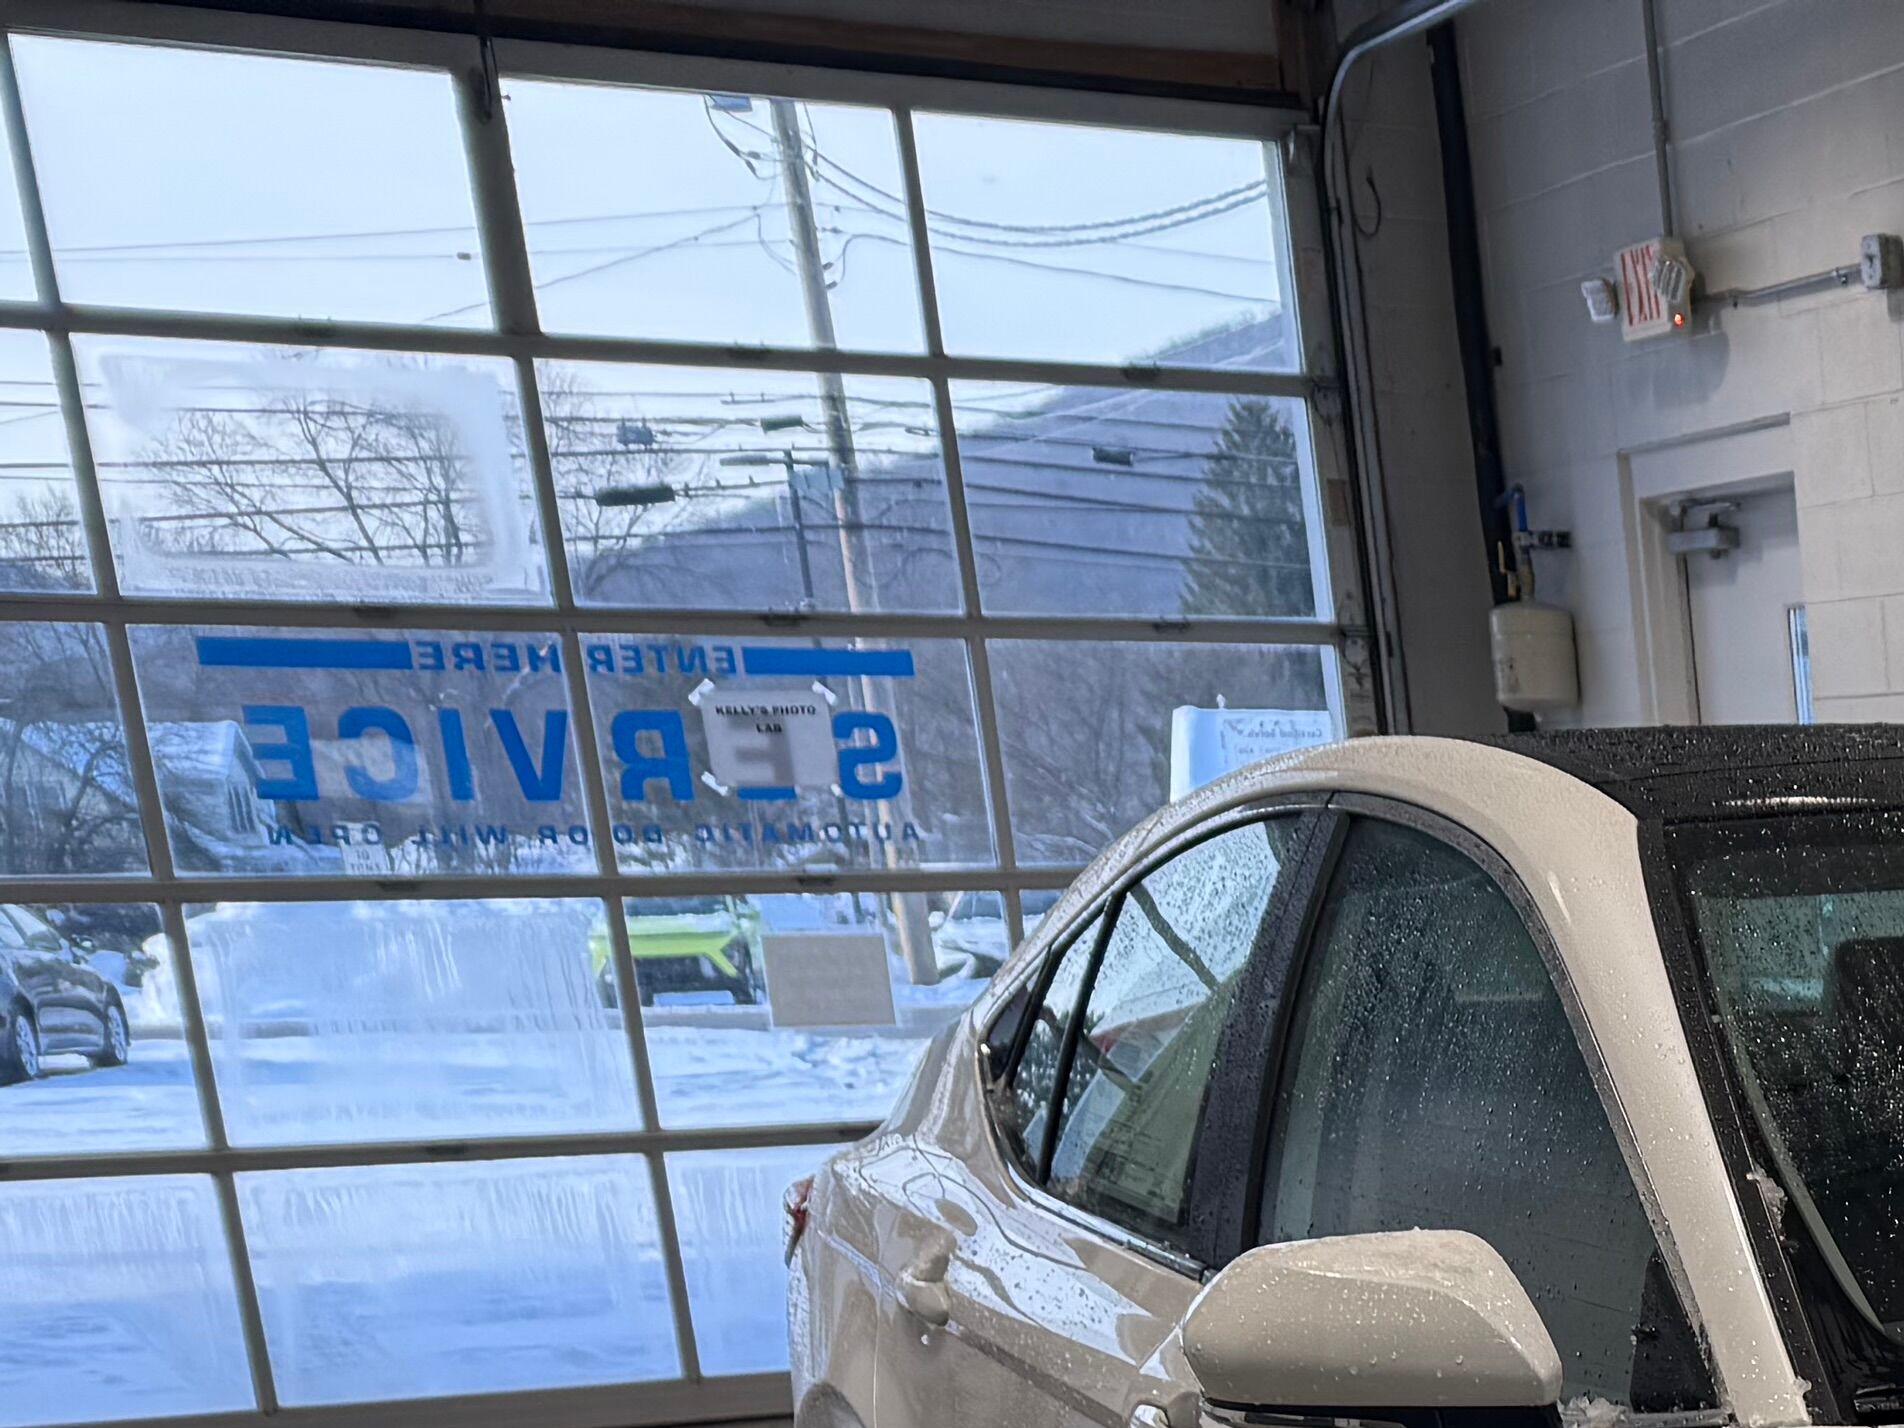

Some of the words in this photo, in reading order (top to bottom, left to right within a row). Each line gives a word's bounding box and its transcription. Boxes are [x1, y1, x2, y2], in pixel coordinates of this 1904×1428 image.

[715, 704, 769, 716] KELLY'S
[772, 704, 817, 716] PHOTO
[755, 722, 783, 734] LAB
